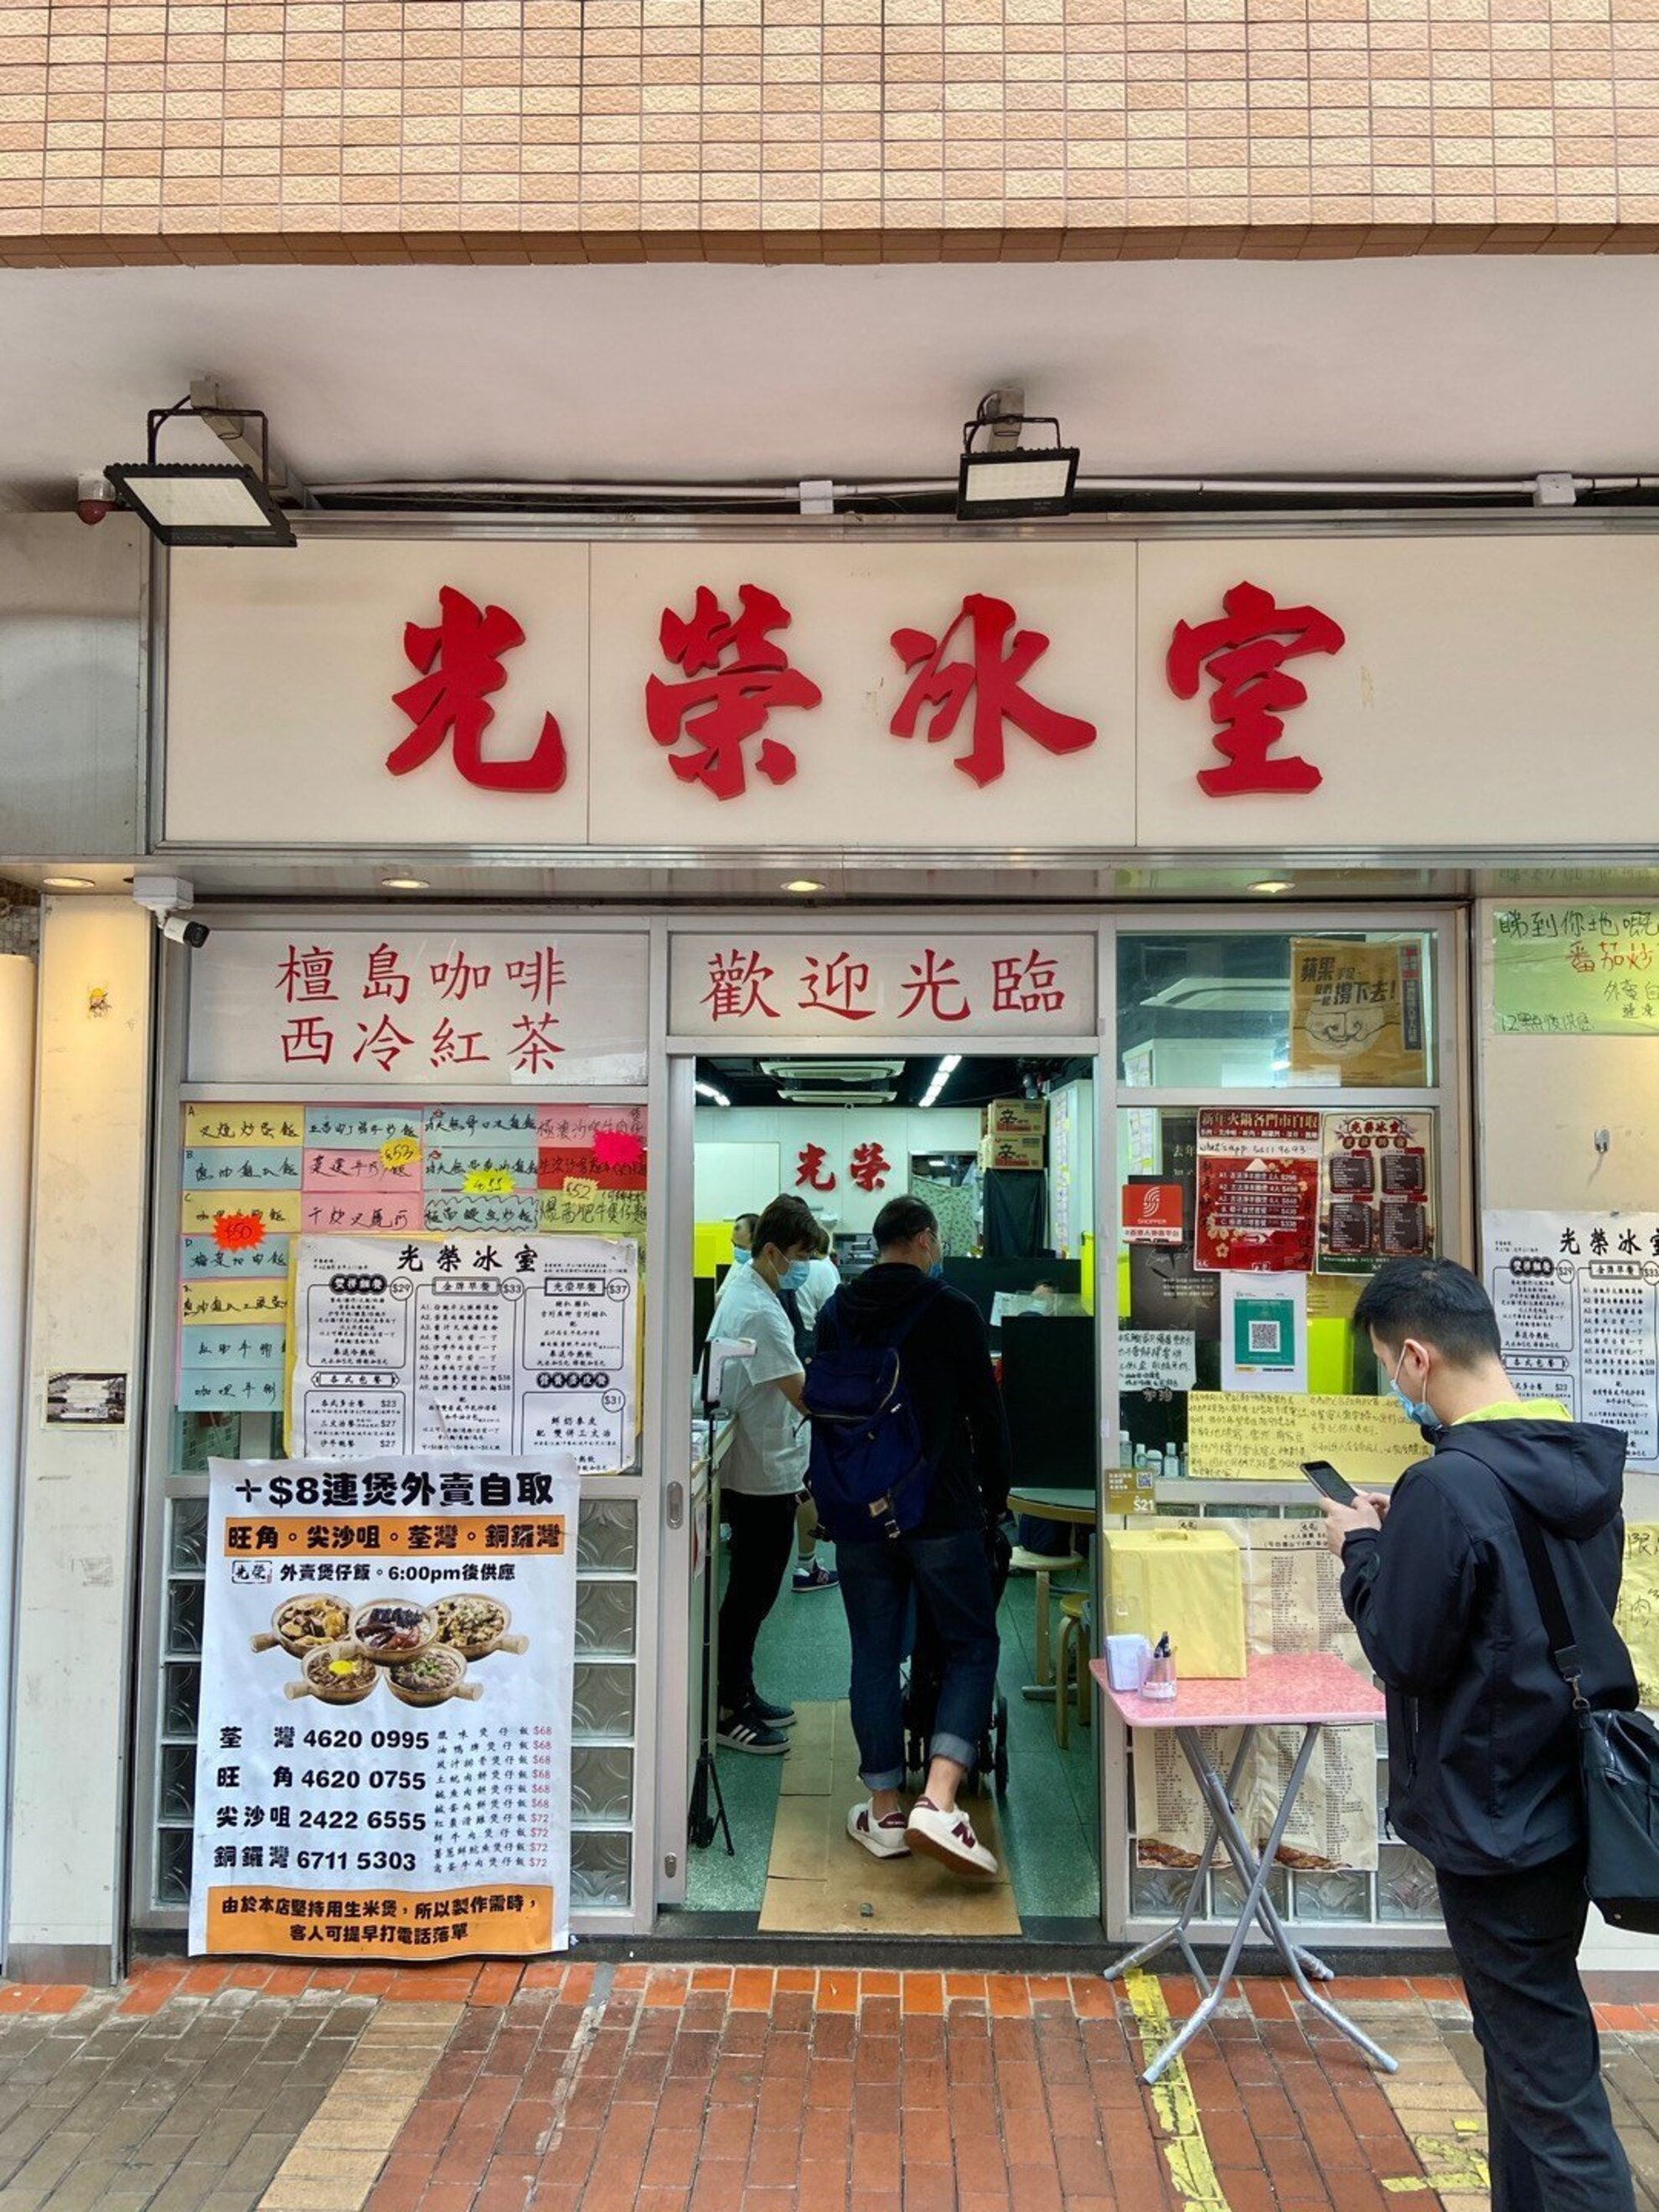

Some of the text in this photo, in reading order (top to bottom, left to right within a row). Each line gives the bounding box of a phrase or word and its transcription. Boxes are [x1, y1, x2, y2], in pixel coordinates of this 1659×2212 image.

[386, 581, 1346, 802] 光榮冰室
[276, 943, 567, 1005] 檀島咖啡
[700, 948, 1066, 1021] 歡迎光臨
[281, 1013, 566, 1075] 西冷紅茶
[189, 1106, 195, 1116] A
[187, 1150, 194, 1159] B
[795, 1143, 892, 1191] 光榮
[185, 1238, 193, 1248] D
[396, 1244, 539, 1273] 光榮冰室
[235, 1471, 554, 1508] +$8連煲外賣自取
[534, 1726, 552, 1735] $68
[220, 1726, 430, 1750] 荃灣 4620 0995
[534, 1740, 552, 1749] $68
[533, 1755, 551, 1764] $68
[217, 1765, 426, 1790] 旺角 4620 0755
[532, 1770, 550, 1779] $68
[532, 1784, 550, 1793] $68
[531, 1799, 550, 1808] $68
[216, 1806, 426, 1832] 尖沙咀 2422 6555
[531, 1814, 550, 1822] $72
[530, 1828, 549, 1837] $72
[530, 1843, 548, 1852] $72
[214, 1846, 416, 1872] 銅鑼灣 6711 5303
[530, 1858, 547, 1868] $72
[289, 1923, 468, 1946] 客人可提早打電話落單
